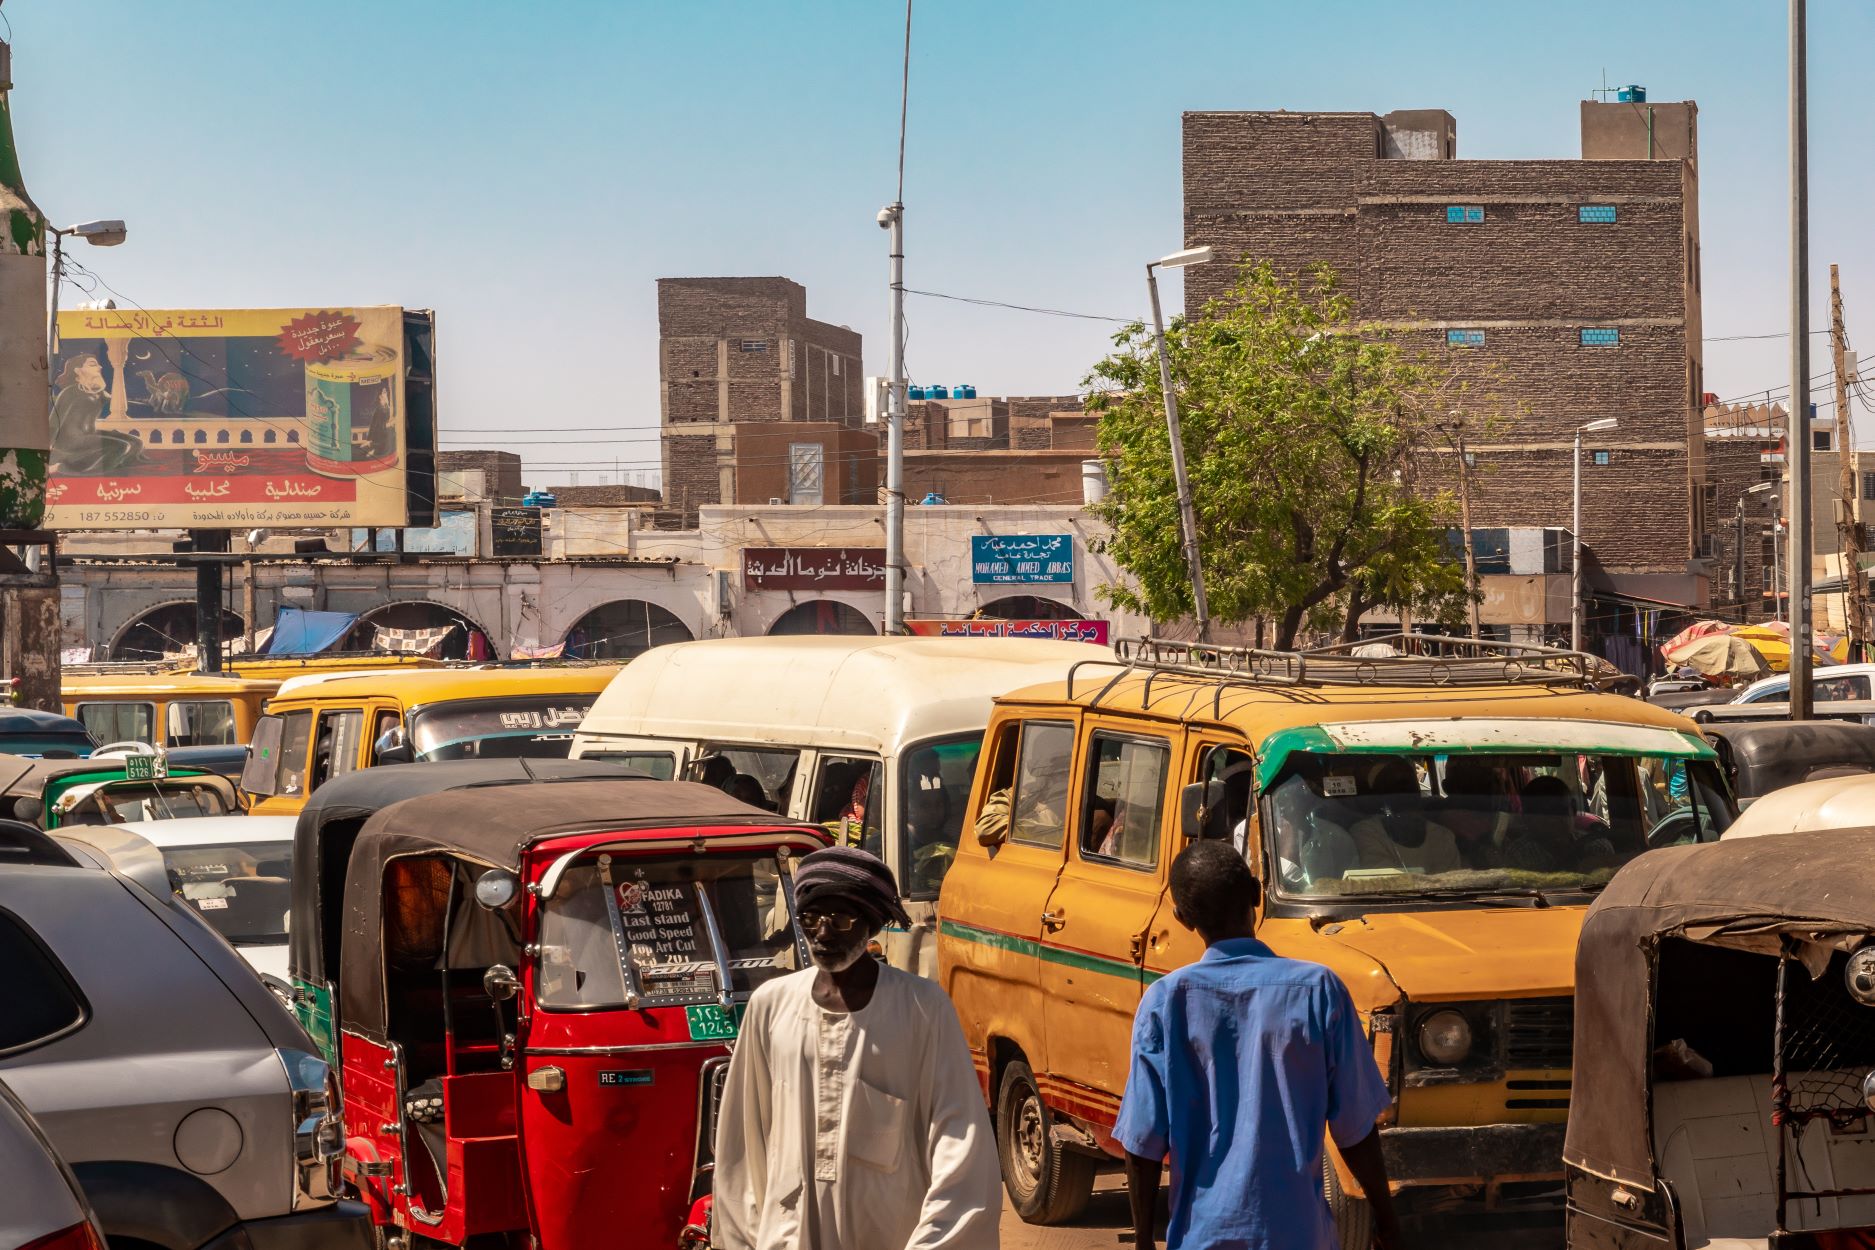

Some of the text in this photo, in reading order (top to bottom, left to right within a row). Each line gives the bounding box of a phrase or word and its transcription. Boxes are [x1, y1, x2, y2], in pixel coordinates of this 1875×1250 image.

[84, 312, 224, 336] الثقة في الأصالة
[291, 319, 343, 338] عبوة جديدة
[297, 331, 345, 351] بسعر معقول
[192, 449, 249, 473] ميسو
[265, 480, 321, 499] صندلية
[79, 512, 101, 521] 187
[104, 511, 150, 521] 552850
[980, 537, 1006, 551] عباس
[1041, 536, 1062, 550] محمد
[1023, 550, 1051, 560] تجارة
[747, 550, 794, 584] الحديثة
[845, 556, 887, 582] جزخانة
[975, 561, 1072, 574] MOHAMED AHMED ABBAS
[1006, 622, 1059, 638] الحكمة
[1061, 622, 1099, 641] مركز
[130, 767, 150, 778] 5126
[641, 888, 684, 902] FADIKA
[652, 900, 674, 911] 12781
[622, 911, 690, 927] Last stand
[627, 926, 694, 941] Good Speed
[631, 938, 697, 957] Top Art Cut
[698, 1021, 734, 1036] 1245
[601, 1073, 616, 1083] RE
